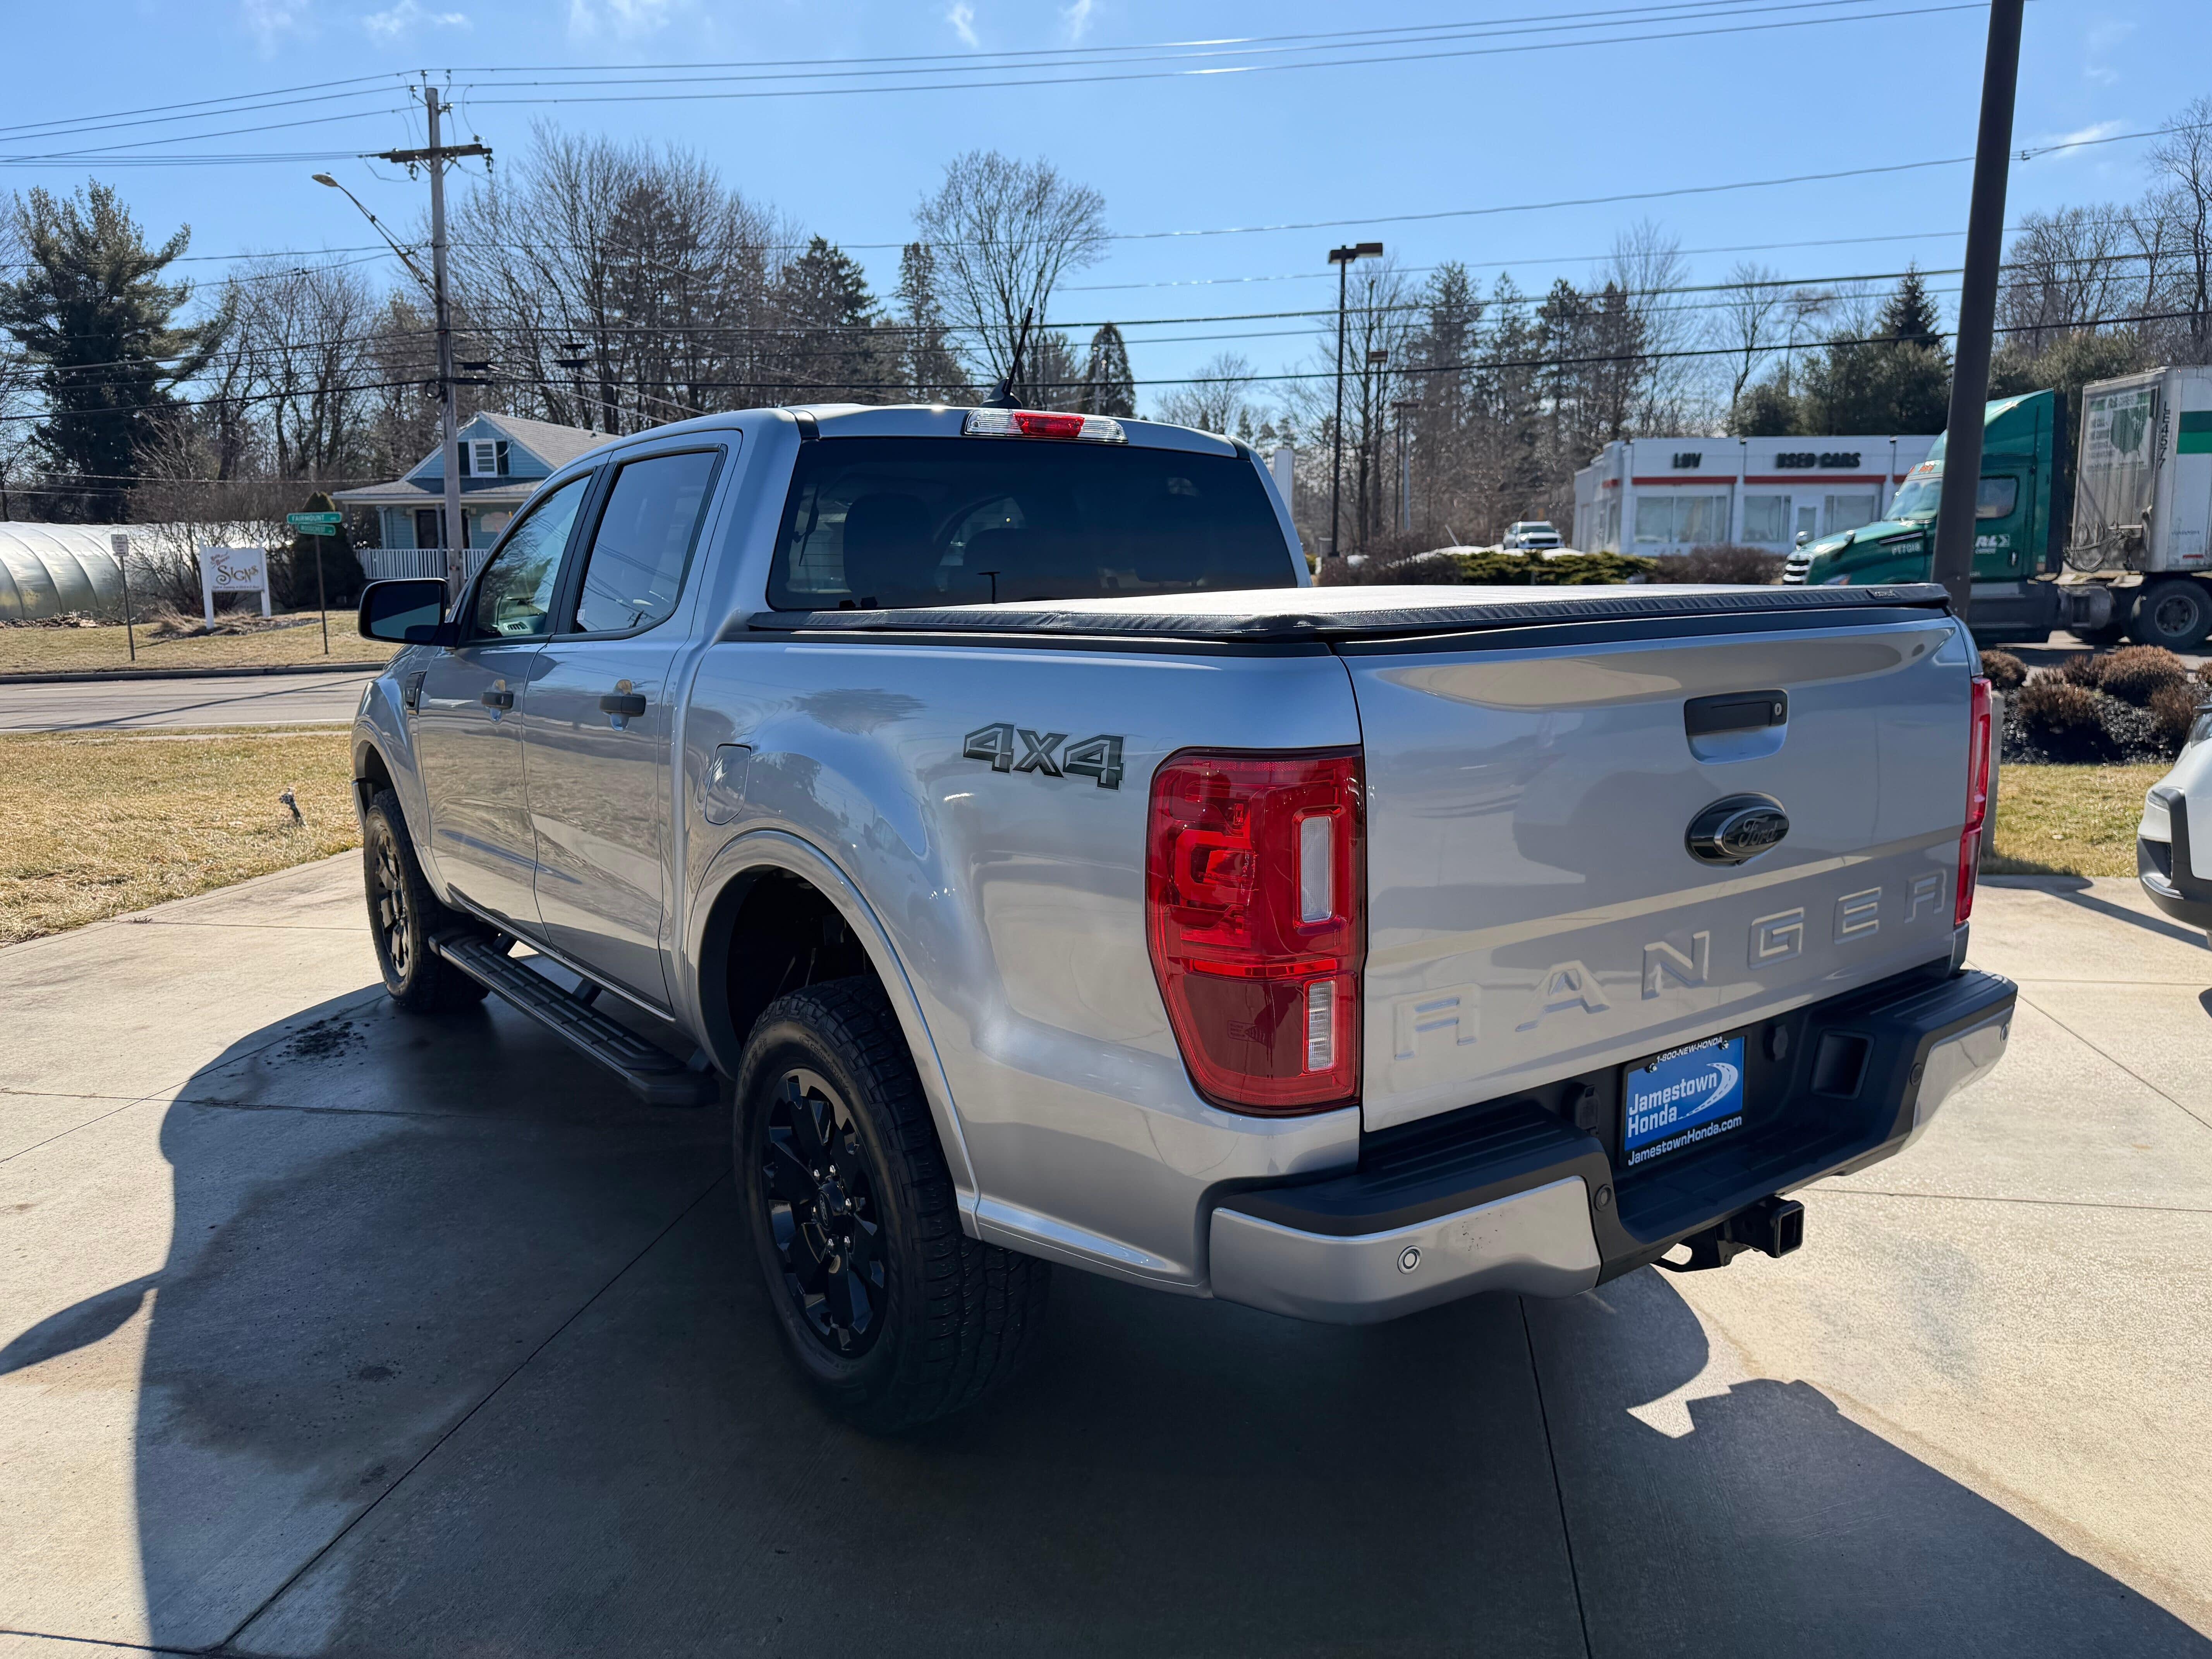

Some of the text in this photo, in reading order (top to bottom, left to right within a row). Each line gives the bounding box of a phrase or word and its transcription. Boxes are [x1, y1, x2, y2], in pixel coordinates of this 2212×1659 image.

[1776, 452, 1816, 469] USED
[1820, 452, 1862, 468] CARS
[1738, 816, 1779, 848] Ford
[1393, 869, 1947, 1060] RANGER
[1656, 1036, 1723, 1063] 1-800-NEW-HONDA
[1629, 1072, 1717, 1116] Jamestown
[1628, 1104, 1677, 1138] Honda
[1628, 1115, 1742, 1166] JamestownHonda.com
